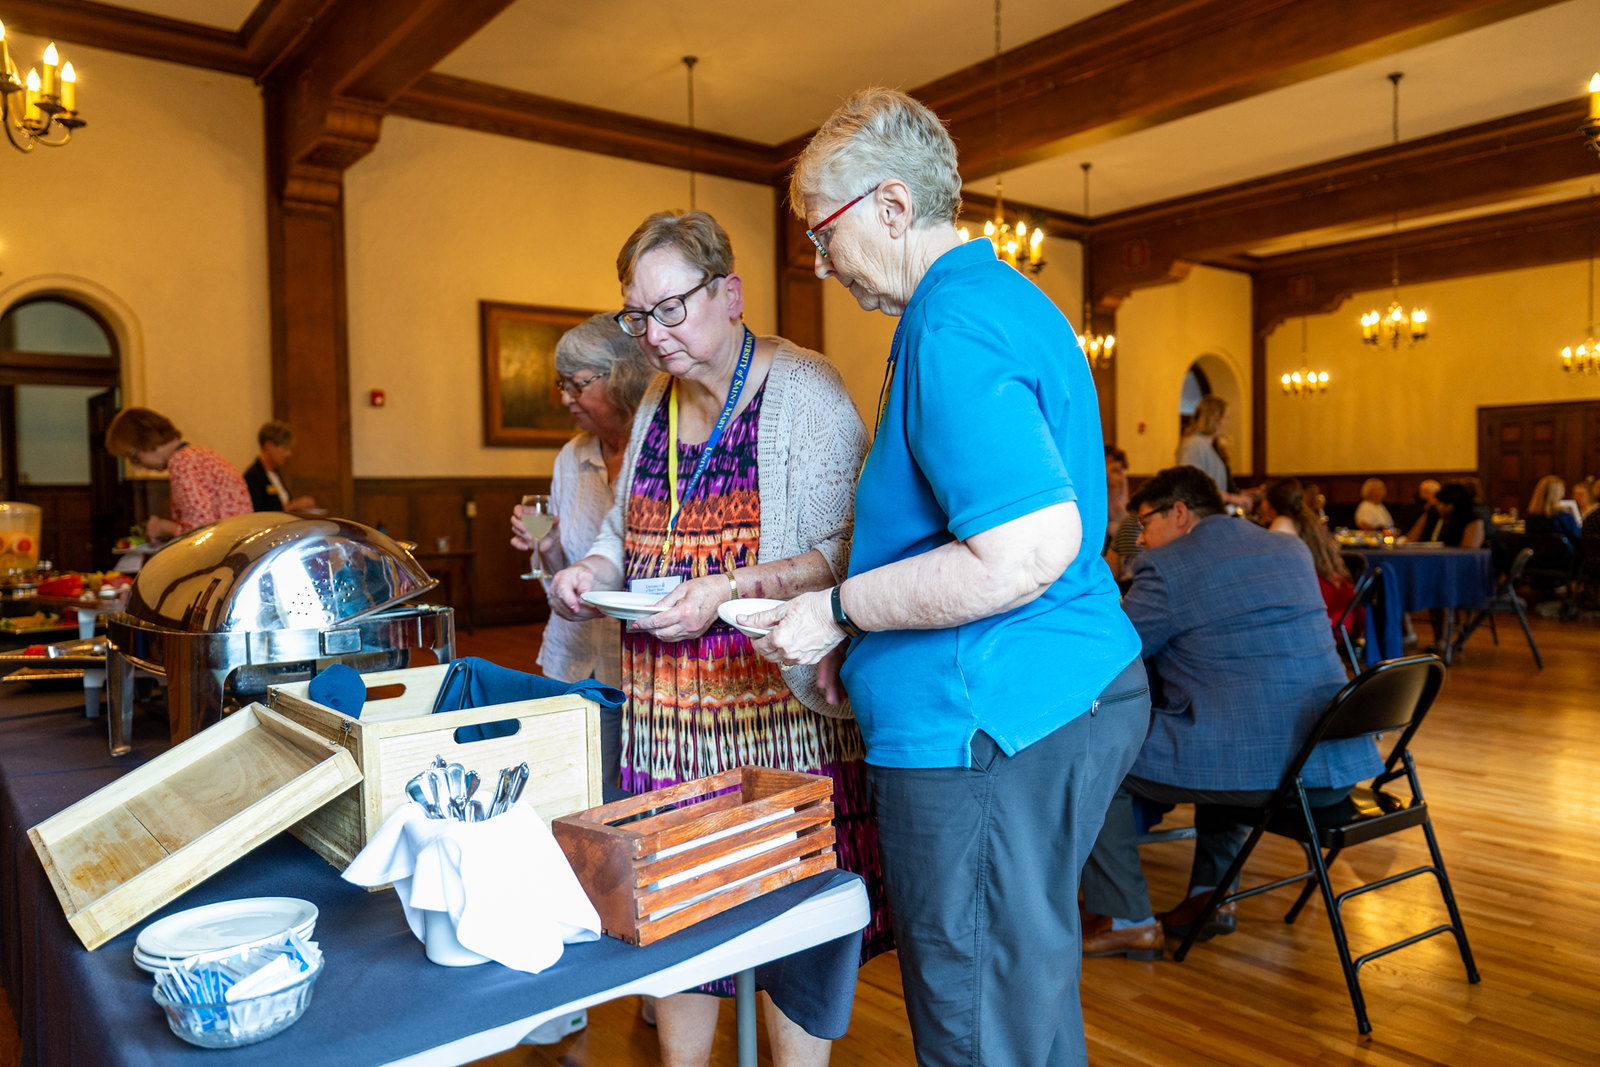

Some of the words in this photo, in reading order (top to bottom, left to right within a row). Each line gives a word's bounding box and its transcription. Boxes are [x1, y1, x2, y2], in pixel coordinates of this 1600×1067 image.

[736, 369, 744, 379] of
[728, 379, 743, 404] SAINT
[717, 407, 732, 430] MARY
